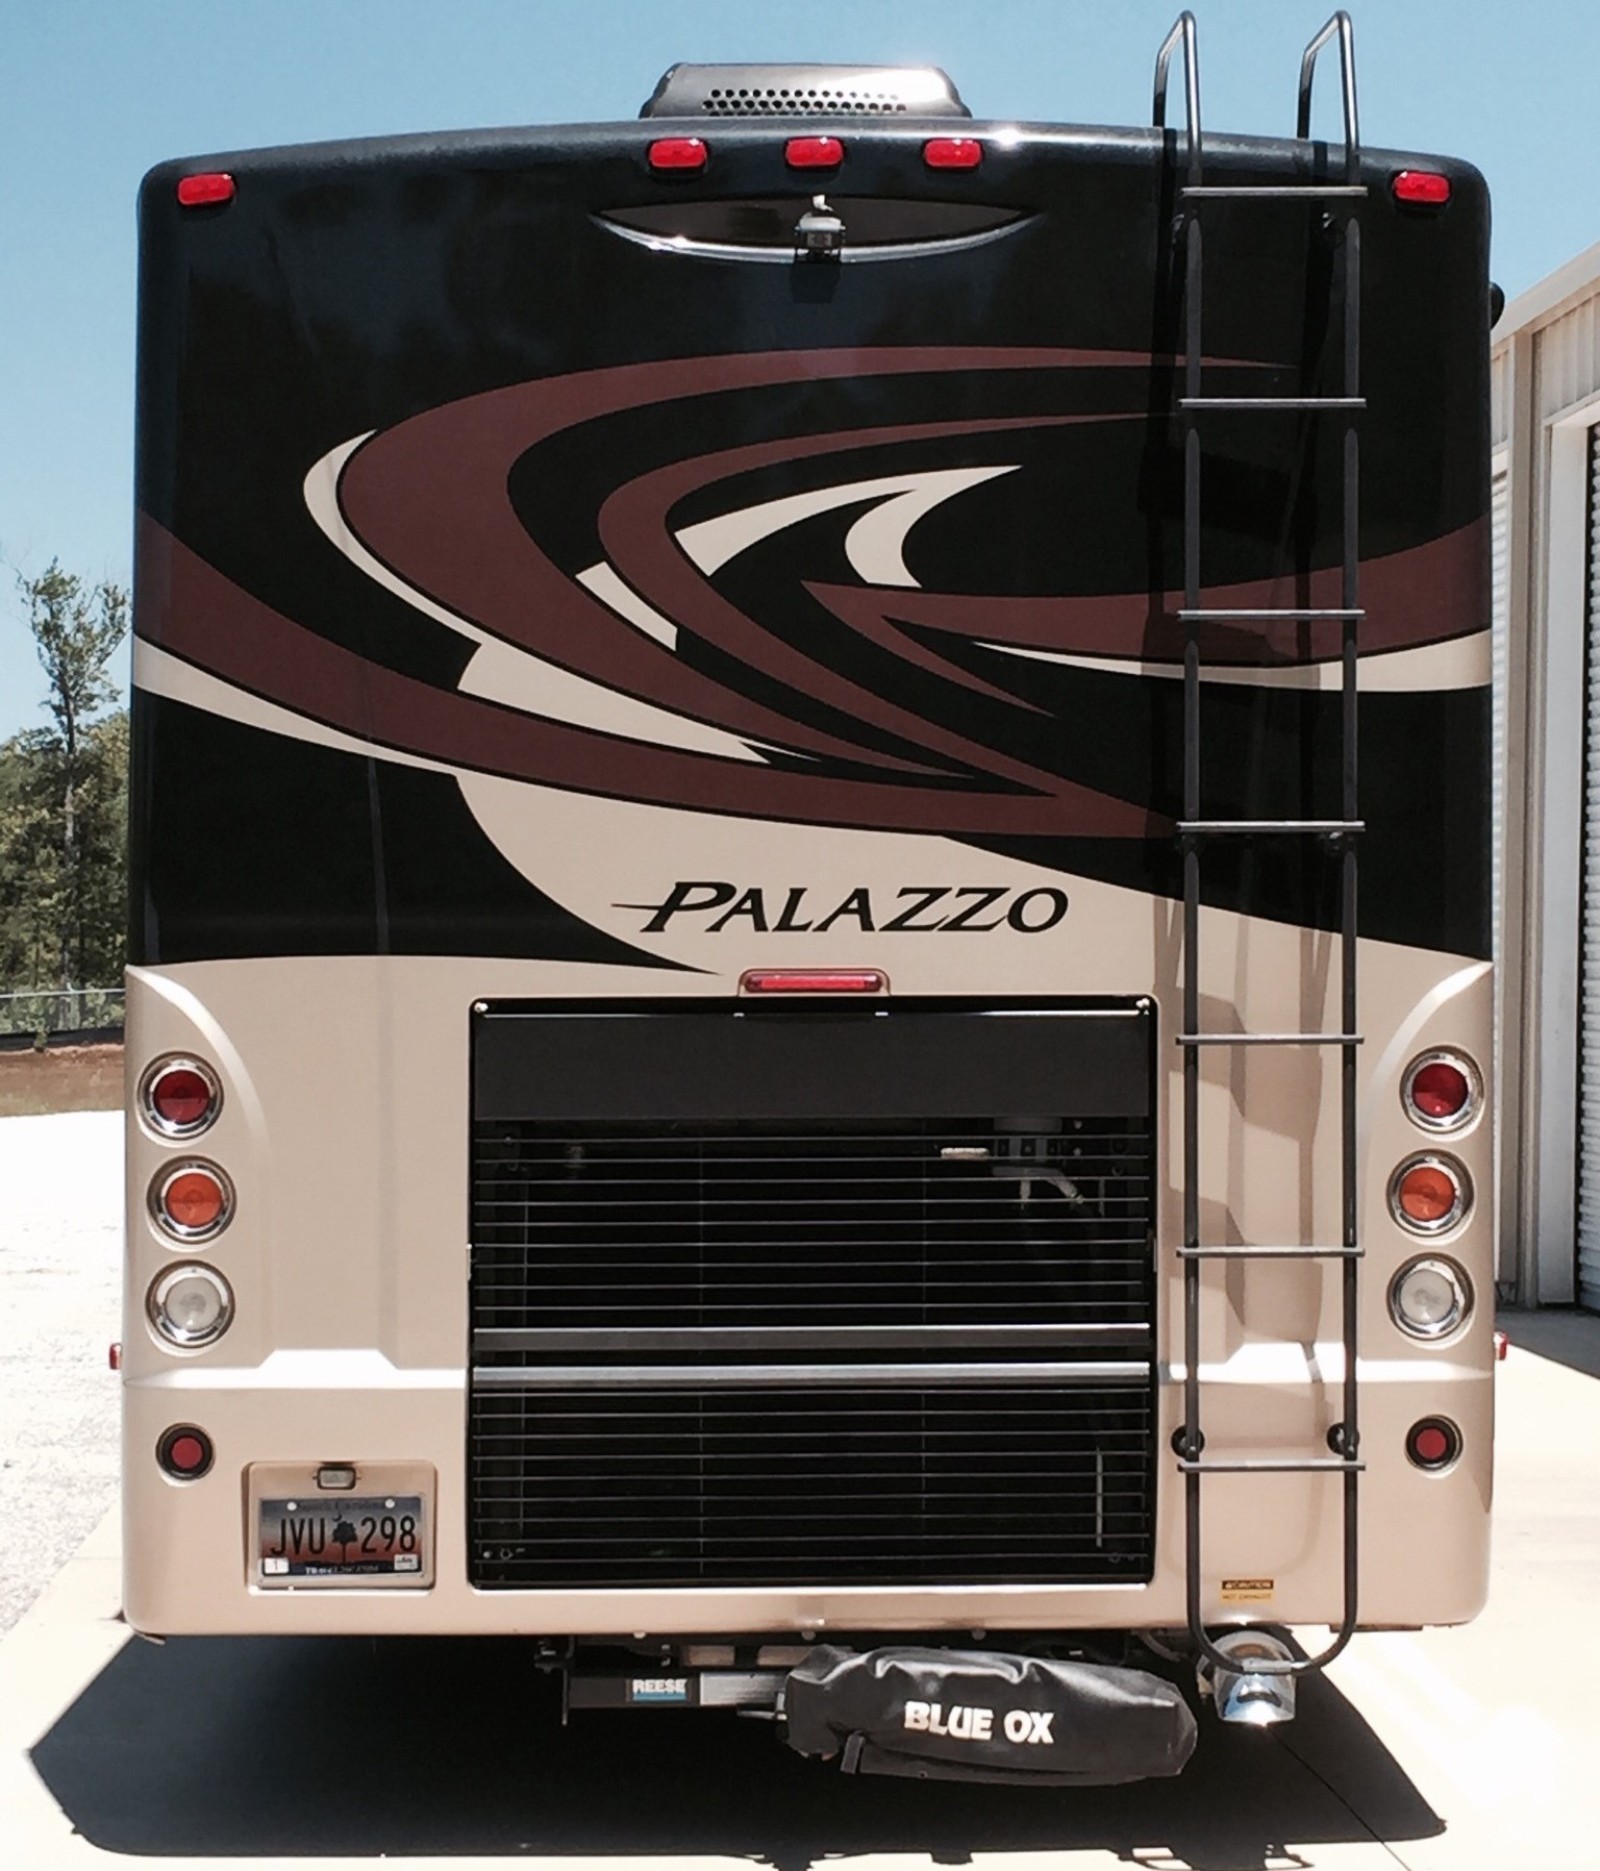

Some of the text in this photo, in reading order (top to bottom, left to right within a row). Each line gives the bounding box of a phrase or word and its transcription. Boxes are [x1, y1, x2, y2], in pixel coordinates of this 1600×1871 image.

[611, 881, 1068, 933] PALAZZO
[270, 1515, 416, 1556] JVU 298
[632, 1678, 688, 1694] REESE
[904, 1700, 1054, 1744] BLUE OX
